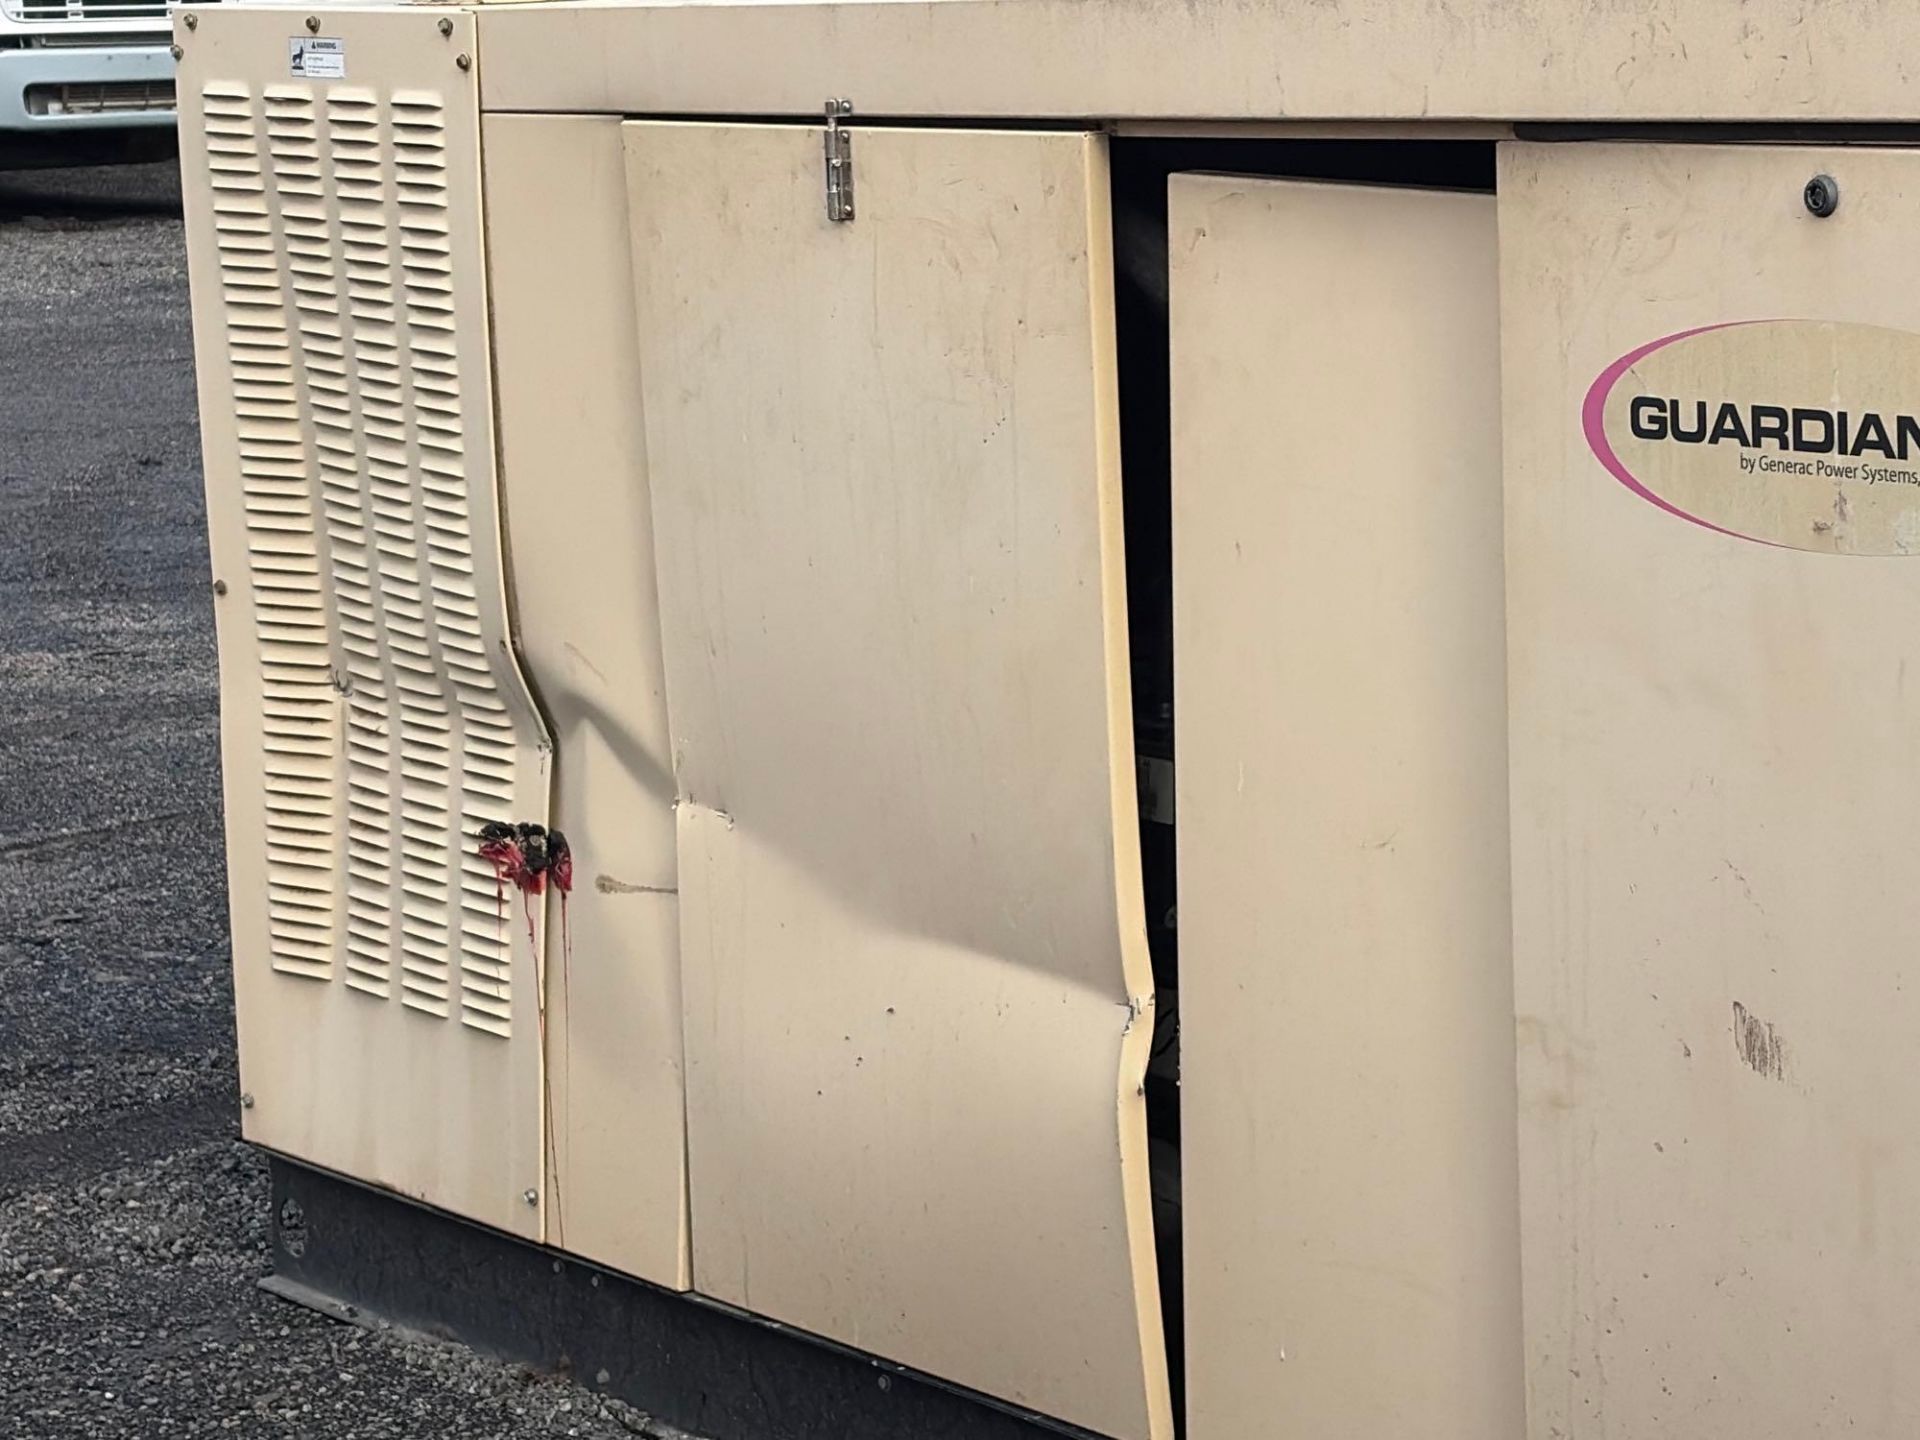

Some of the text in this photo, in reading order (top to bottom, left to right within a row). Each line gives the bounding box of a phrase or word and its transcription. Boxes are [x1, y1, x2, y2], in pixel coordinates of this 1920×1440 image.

[1630, 396, 1920, 460] GUARDIAN
[1740, 453, 1920, 487] by Generac Power Systems,
